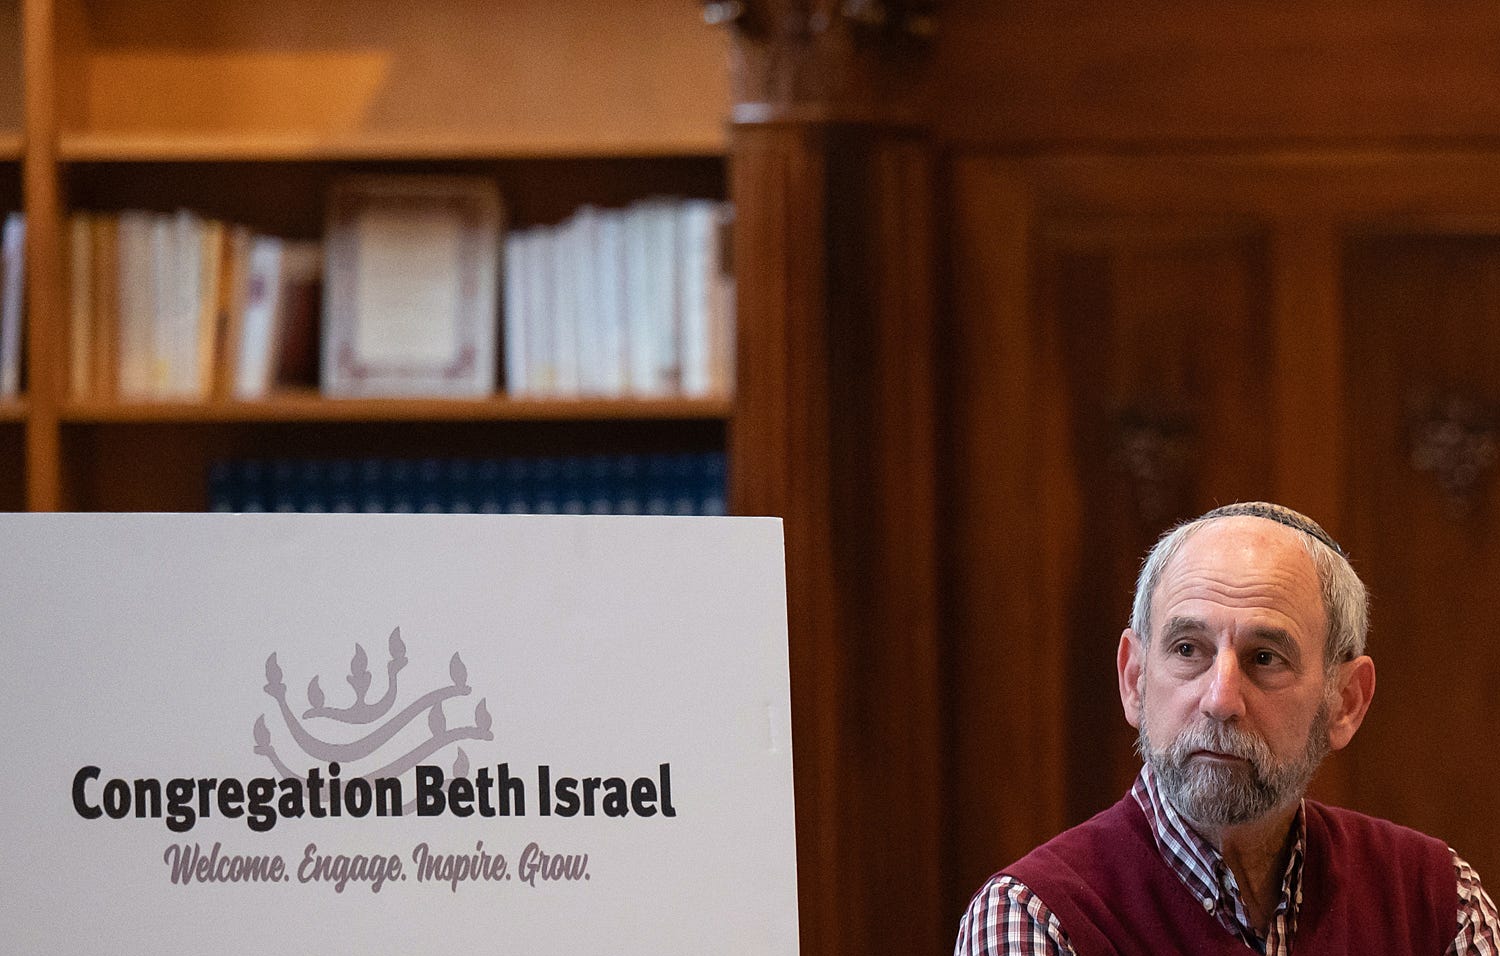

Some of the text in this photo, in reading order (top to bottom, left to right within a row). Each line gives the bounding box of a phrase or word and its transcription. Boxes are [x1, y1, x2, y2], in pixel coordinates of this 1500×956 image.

[72, 762, 677, 832] Congregation Beth Israel
[163, 840, 591, 894] Welcome. Engage. Inspire. Grow.
